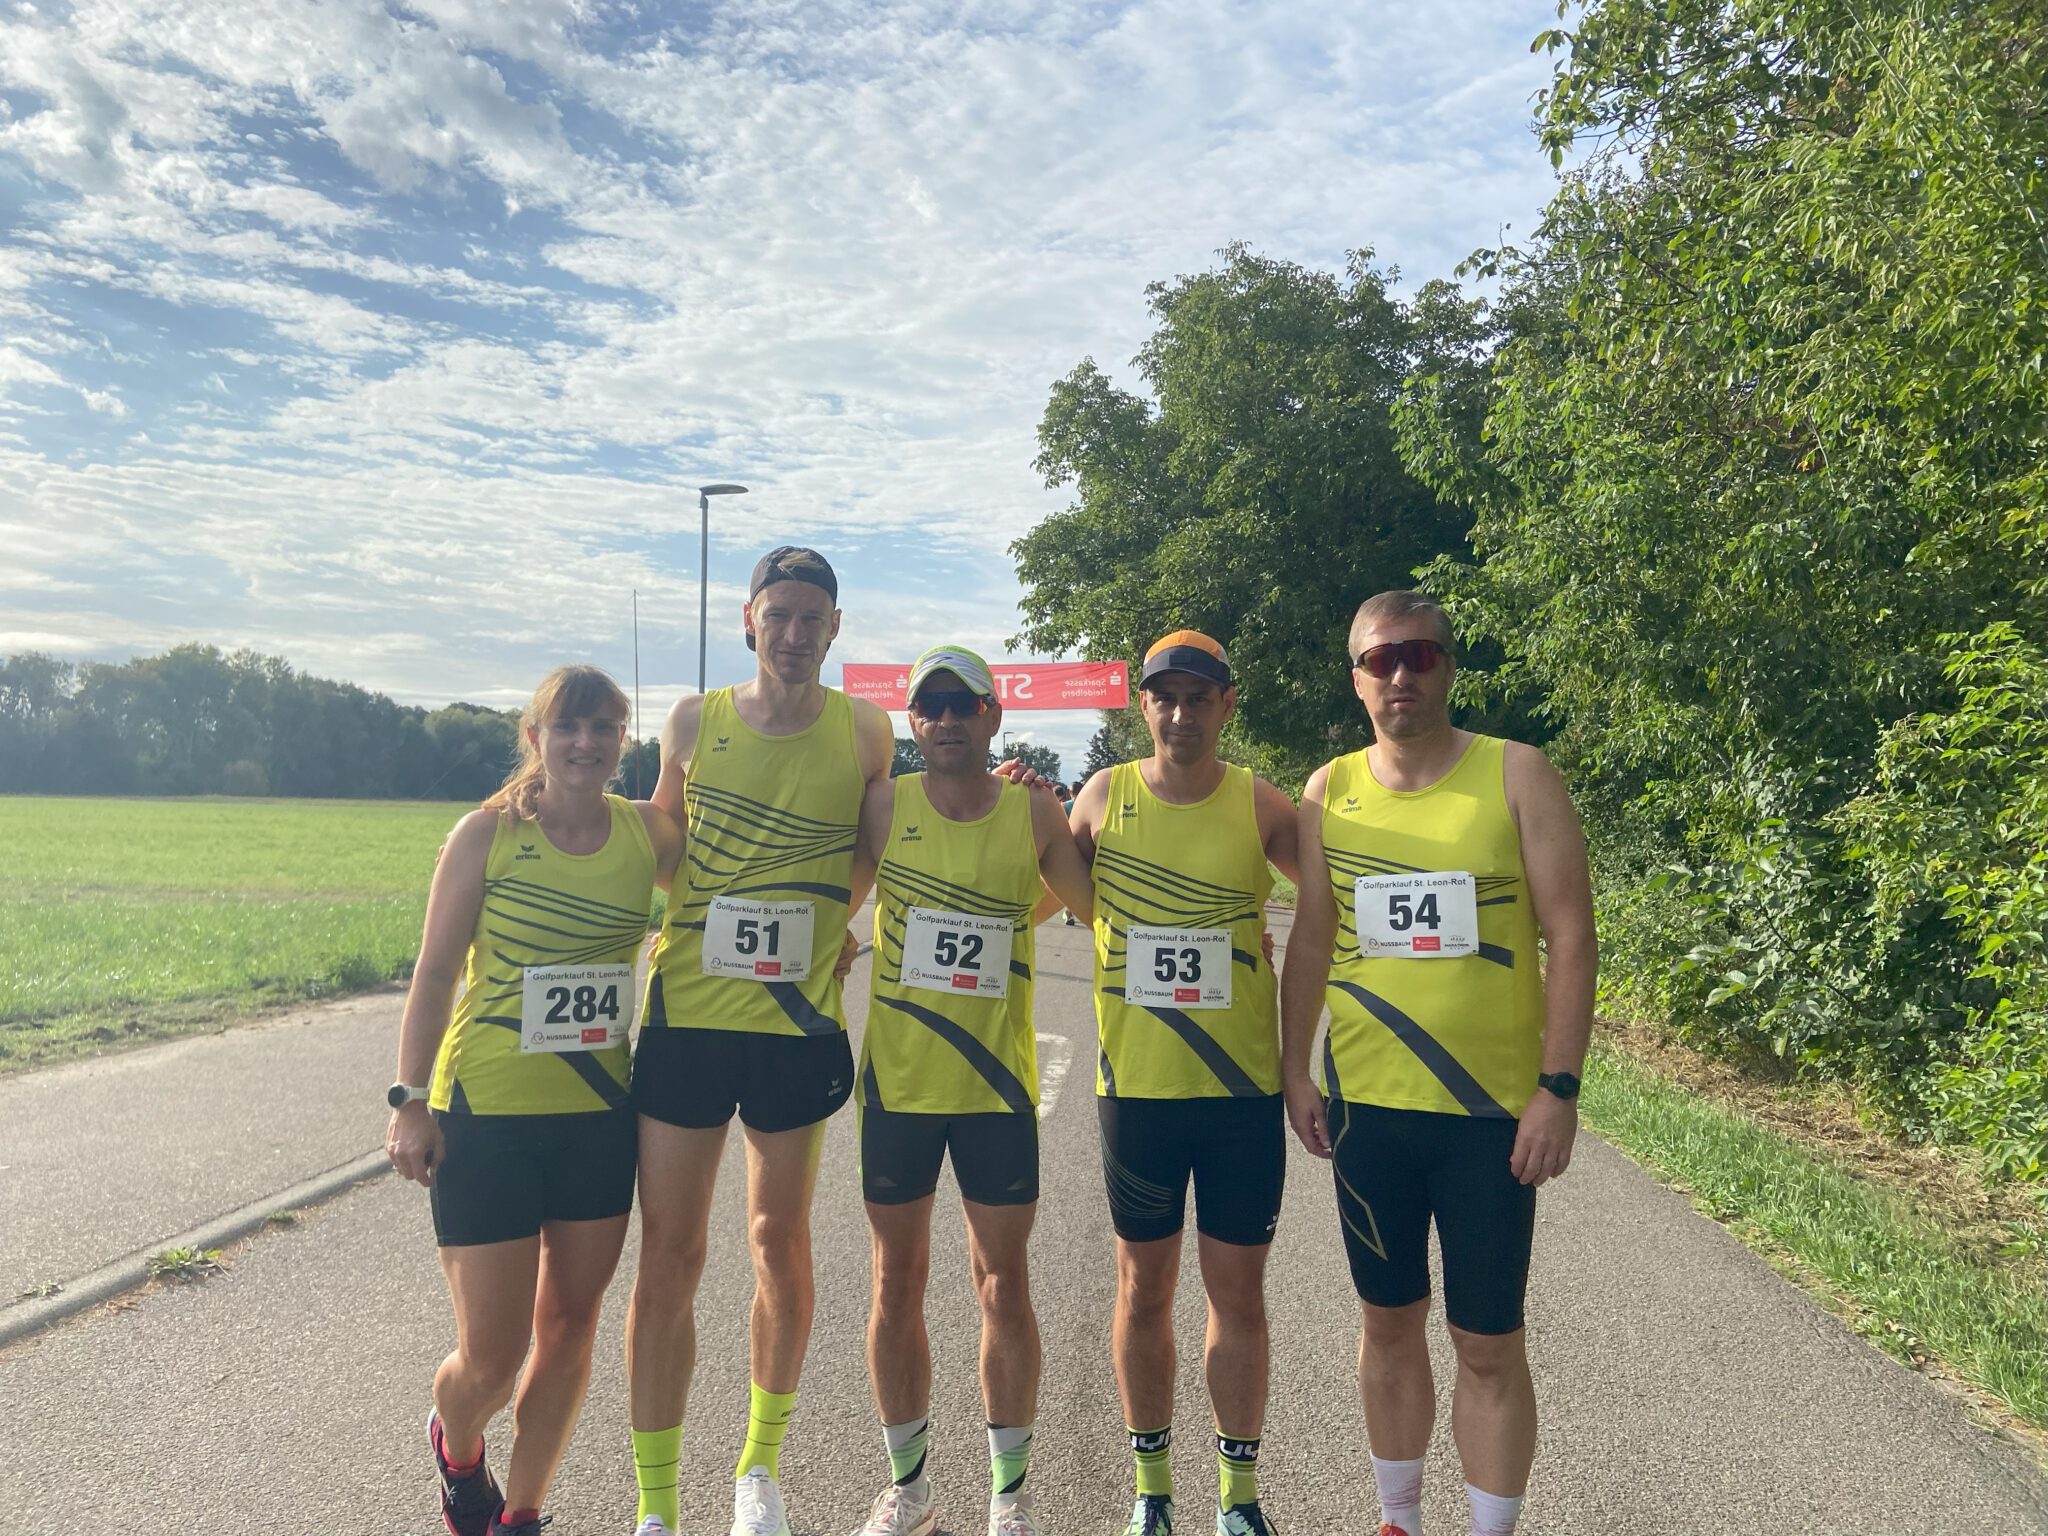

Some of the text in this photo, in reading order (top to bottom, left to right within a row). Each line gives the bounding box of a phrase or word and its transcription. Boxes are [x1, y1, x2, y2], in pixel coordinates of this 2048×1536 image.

[1364, 880, 1412, 890] Golfparklauf
[1427, 878, 1466, 887] Leon-Rot
[716, 902, 761, 914] Golfparklauf
[1389, 894, 1441, 931] 54
[916, 914, 1008, 932] Golfparklauf St. Leon-Rot
[735, 919, 780, 956] 51
[1134, 932, 1178, 942] Golfparklauf
[934, 930, 983, 970] 52
[723, 962, 754, 970] NUSSBAUM
[1154, 947, 1201, 983] 53
[532, 972, 585, 981] Golfparklauf
[599, 970, 630, 978] Leon-Rot
[921, 973, 951, 982] NUSSBAUM
[544, 984, 619, 1024] 284
[546, 1033, 580, 1041] NUSSBAUM
